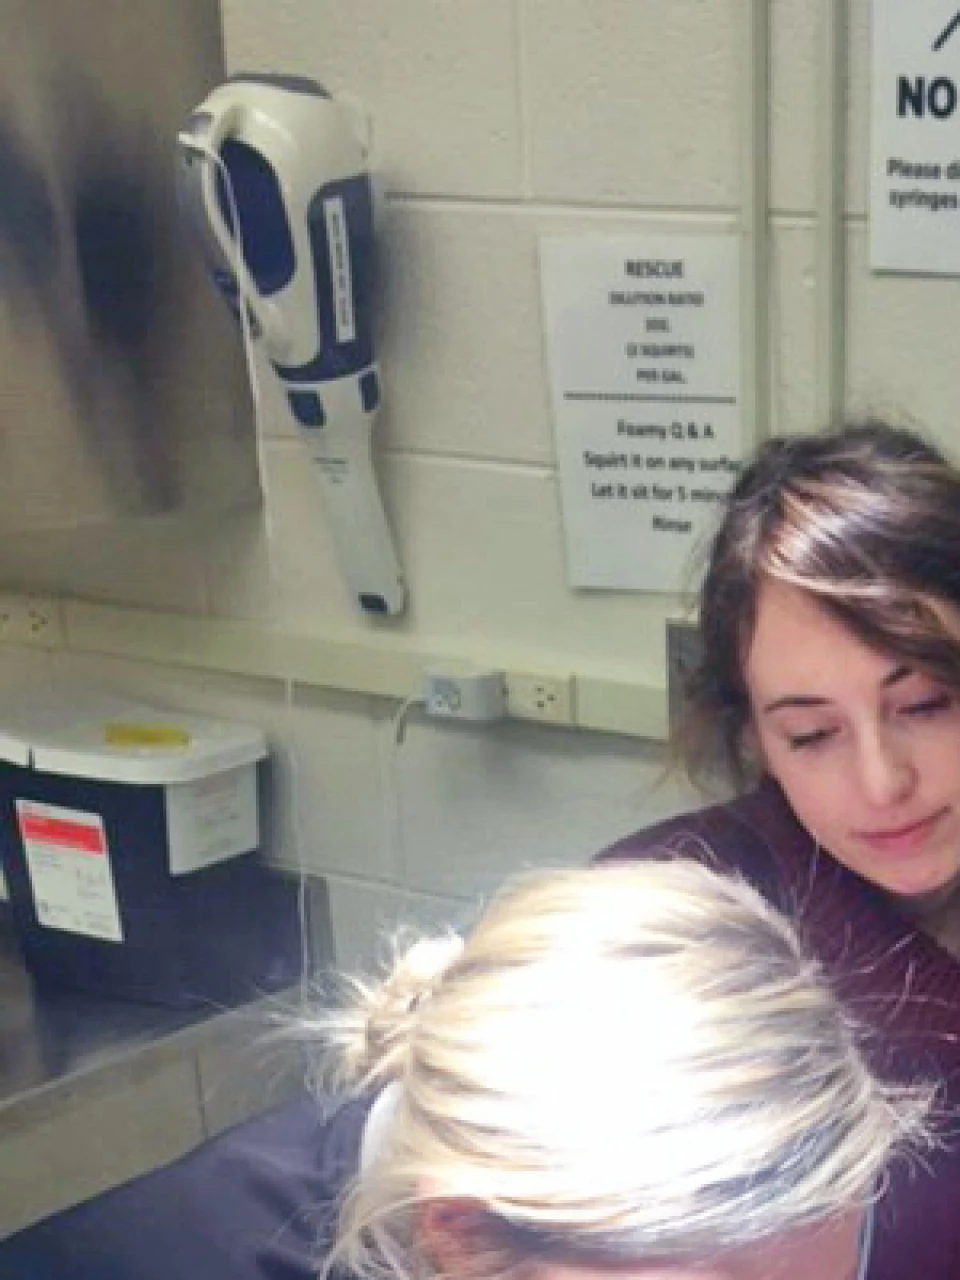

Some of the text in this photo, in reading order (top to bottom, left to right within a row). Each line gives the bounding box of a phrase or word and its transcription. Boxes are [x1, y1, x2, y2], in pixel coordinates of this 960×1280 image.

[897, 76, 958, 119] NO
[886, 157, 941, 180] Please
[889, 189, 958, 212] syringes
[625, 259, 684, 278] RESCUE
[617, 419, 716, 441] Foamy Q & A
[583, 449, 628, 470] Squirt
[631, 453, 642, 469] it
[646, 456, 666, 470] on
[669, 456, 695, 473] any
[591, 482, 614, 499] Let
[617, 483, 628, 499] it
[652, 483, 674, 501] for
